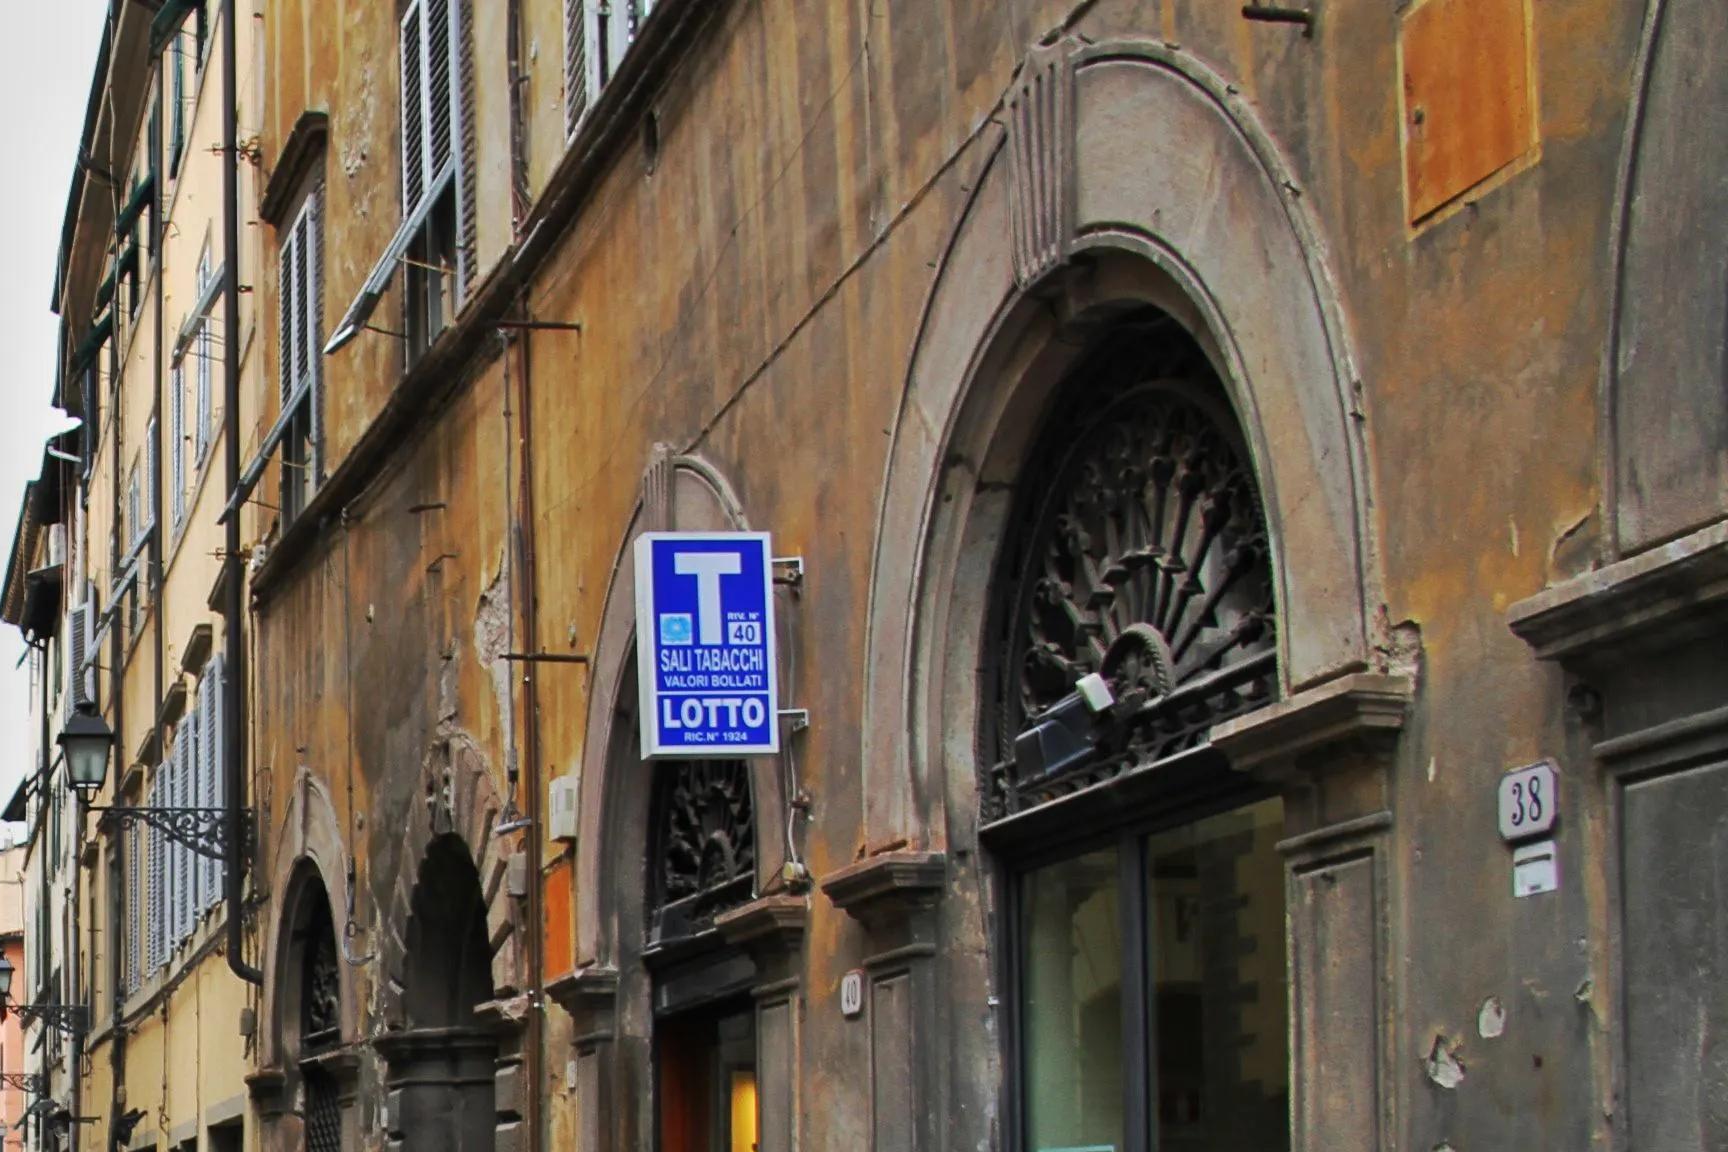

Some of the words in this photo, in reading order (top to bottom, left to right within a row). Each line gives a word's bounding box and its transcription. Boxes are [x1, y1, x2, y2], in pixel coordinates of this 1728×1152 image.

[674, 552, 742, 645] T
[733, 624, 756, 642] 40
[661, 648, 692, 672] SALI
[694, 648, 764, 672] TABACCHI
[664, 675, 709, 688] VALORI
[711, 675, 762, 688] BOLLATI
[663, 697, 765, 729] LOTTO
[722, 731, 748, 742] 1924
[1511, 775, 1542, 827] 38
